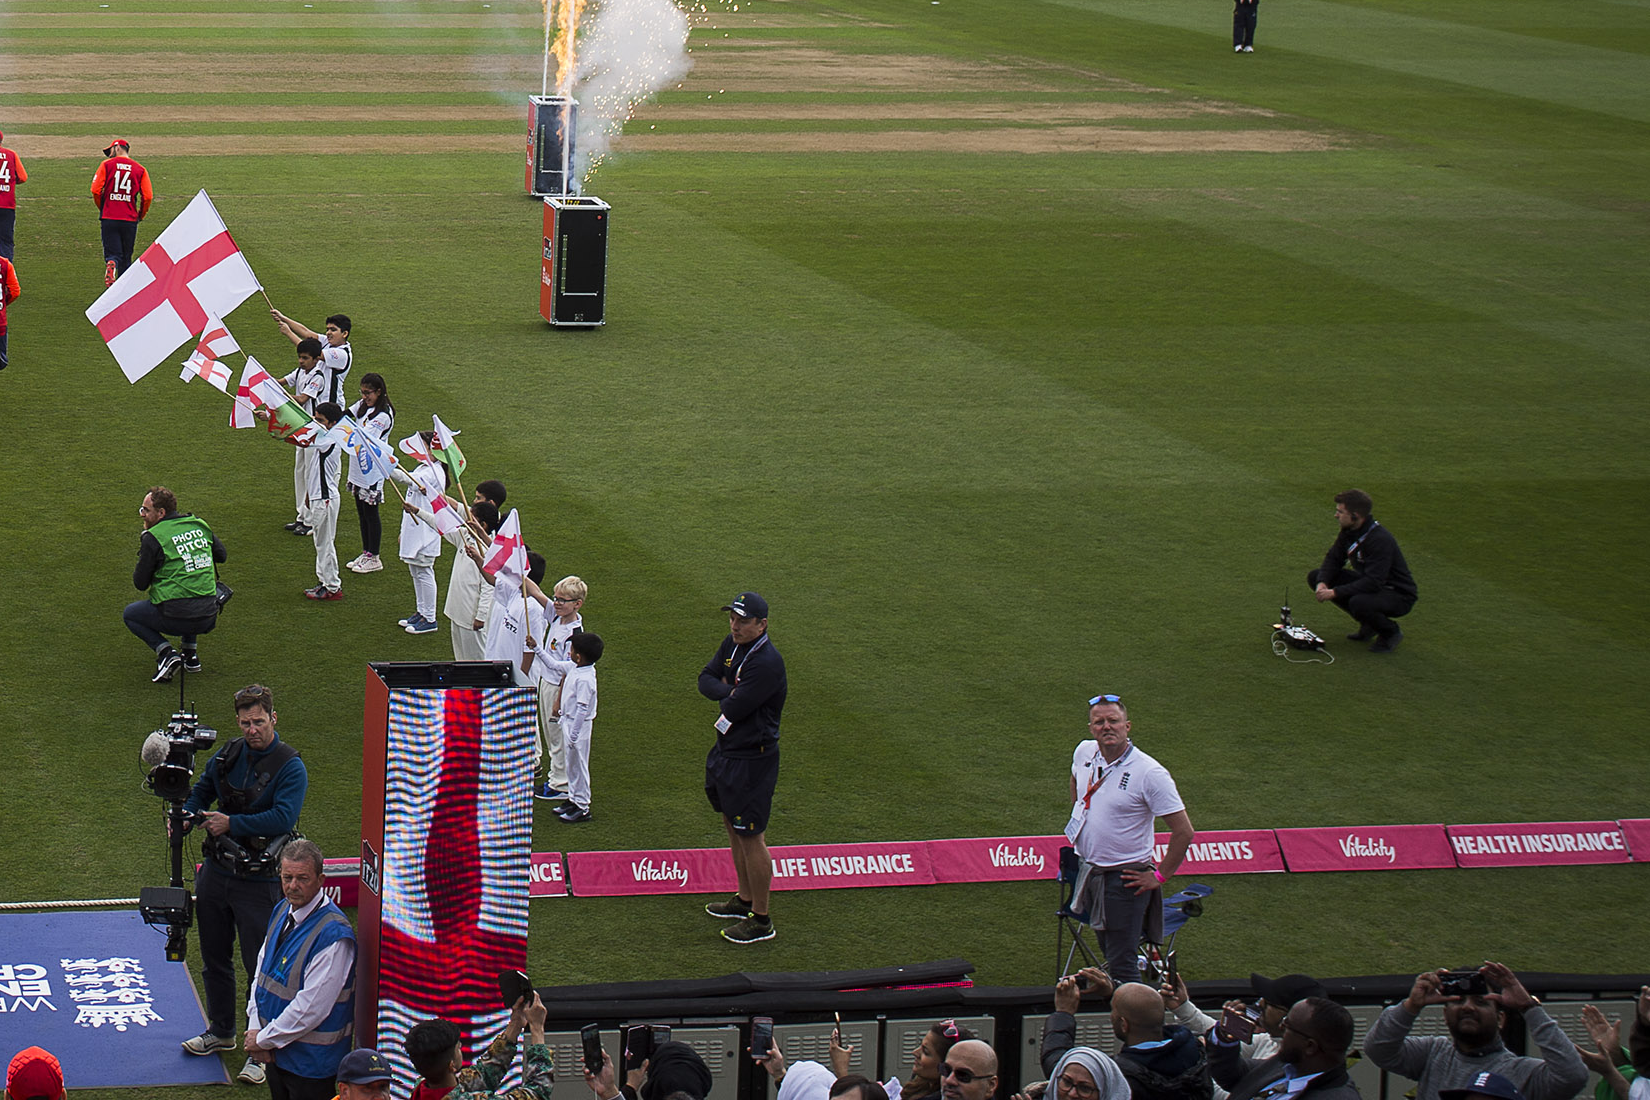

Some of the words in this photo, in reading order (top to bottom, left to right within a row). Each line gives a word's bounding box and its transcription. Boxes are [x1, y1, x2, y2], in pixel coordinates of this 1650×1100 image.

[113, 170, 132, 194] 14
[171, 529, 204, 546] PHOTO
[176, 537, 209, 556] PITCH
[1338, 834, 1396, 863] Vitality
[1451, 834, 1522, 854] HEALTH
[1521, 831, 1625, 853] INSURANCE
[771, 857, 809, 879] LIFE
[811, 853, 915, 877] INSURANCE
[988, 842, 1045, 873] Vitality
[631, 856, 689, 886] Vitality
